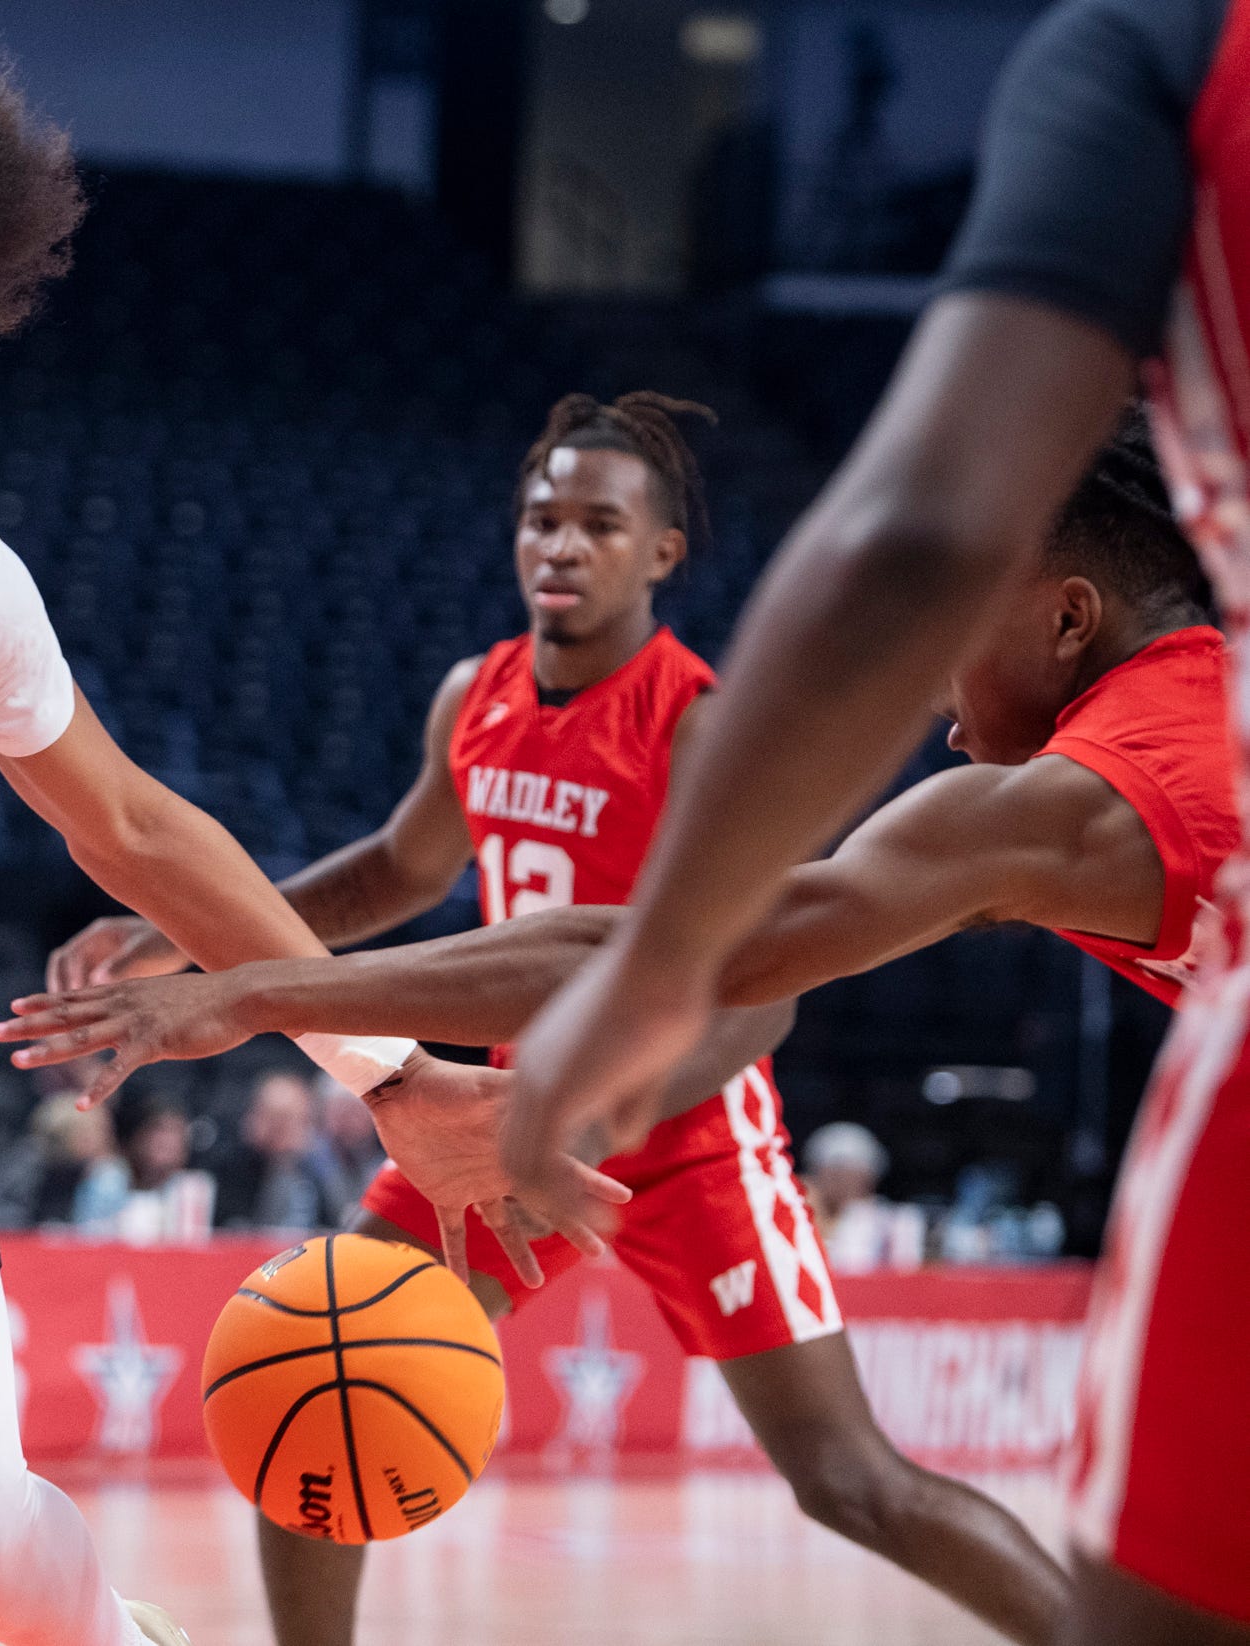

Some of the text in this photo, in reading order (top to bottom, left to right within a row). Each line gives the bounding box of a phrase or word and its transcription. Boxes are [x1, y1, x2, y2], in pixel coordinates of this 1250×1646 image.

[466, 765, 610, 838] WADLEY
[479, 833, 576, 926] 12
[709, 1259, 757, 1317] W
